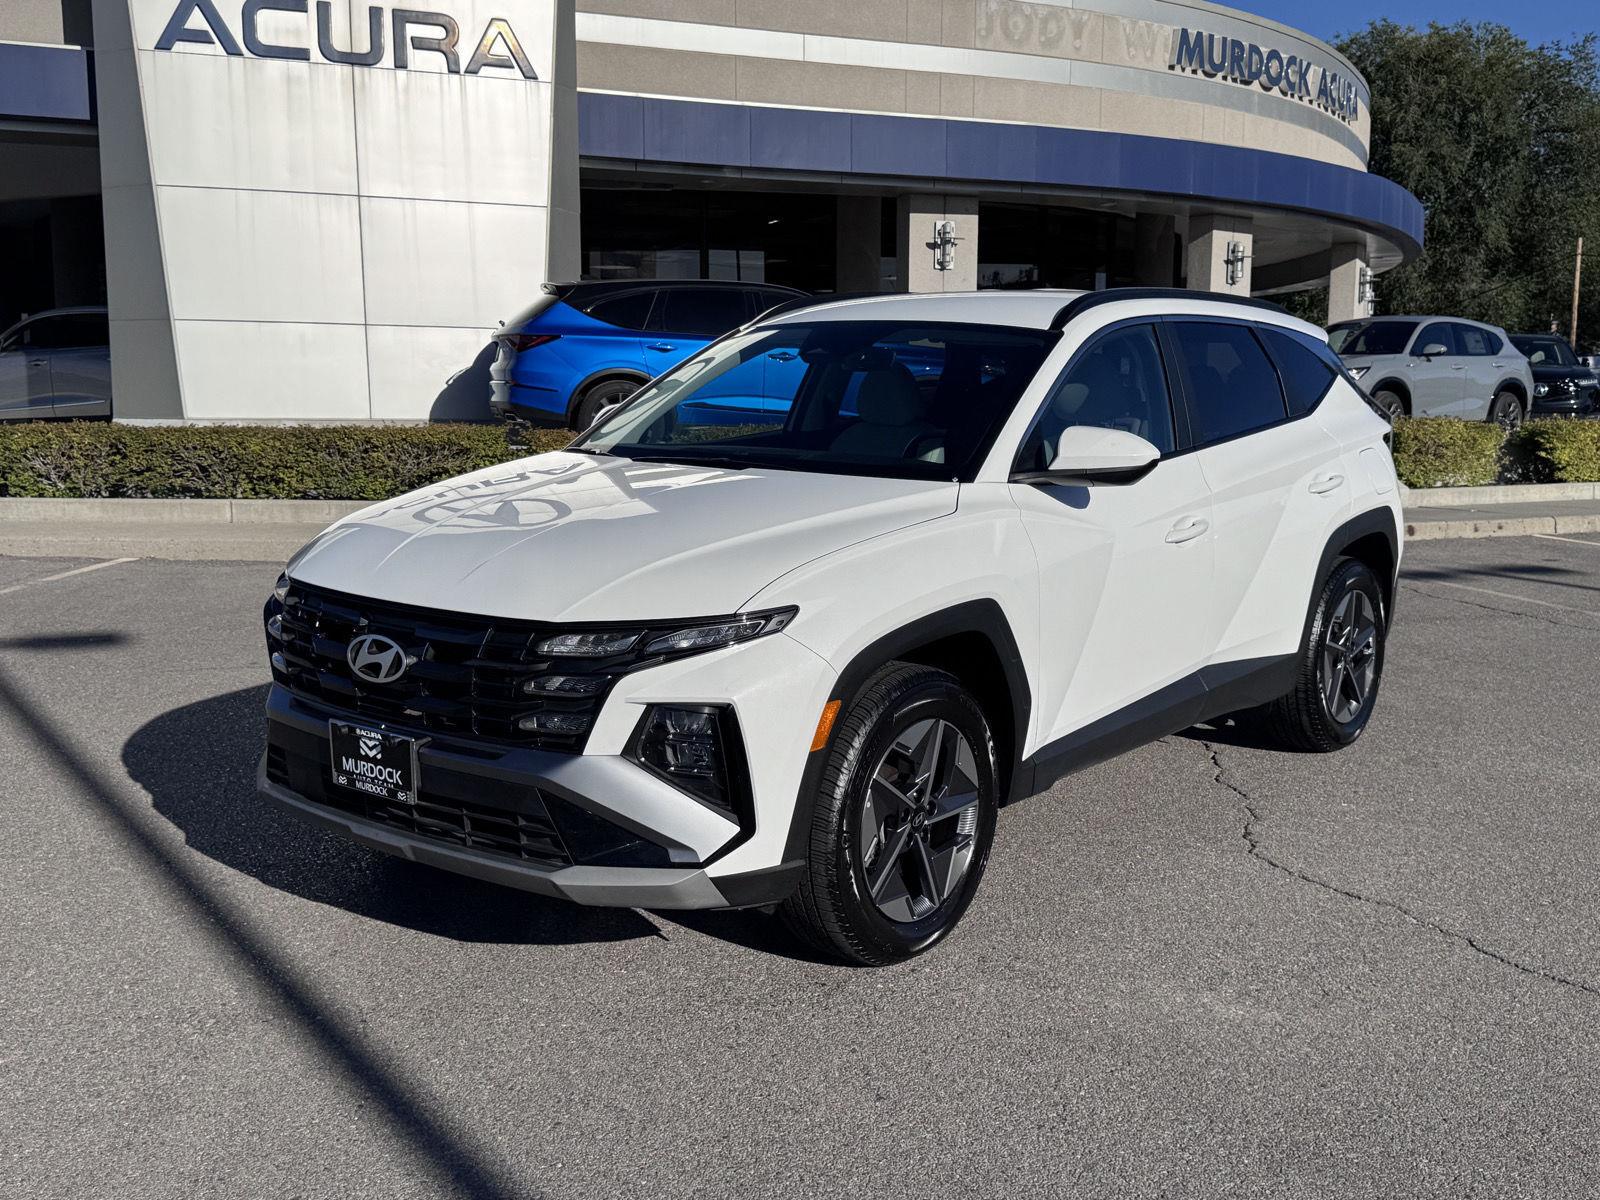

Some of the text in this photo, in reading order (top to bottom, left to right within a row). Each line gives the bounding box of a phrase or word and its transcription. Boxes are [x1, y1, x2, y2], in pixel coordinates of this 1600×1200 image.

[154, 0, 539, 80] ACURA
[1171, 27, 1359, 121] MURDOCK ACURA
[361, 729, 382, 740] ACURA
[342, 756, 403, 785] MURDOCK
[355, 780, 388, 796] MURDOCK
